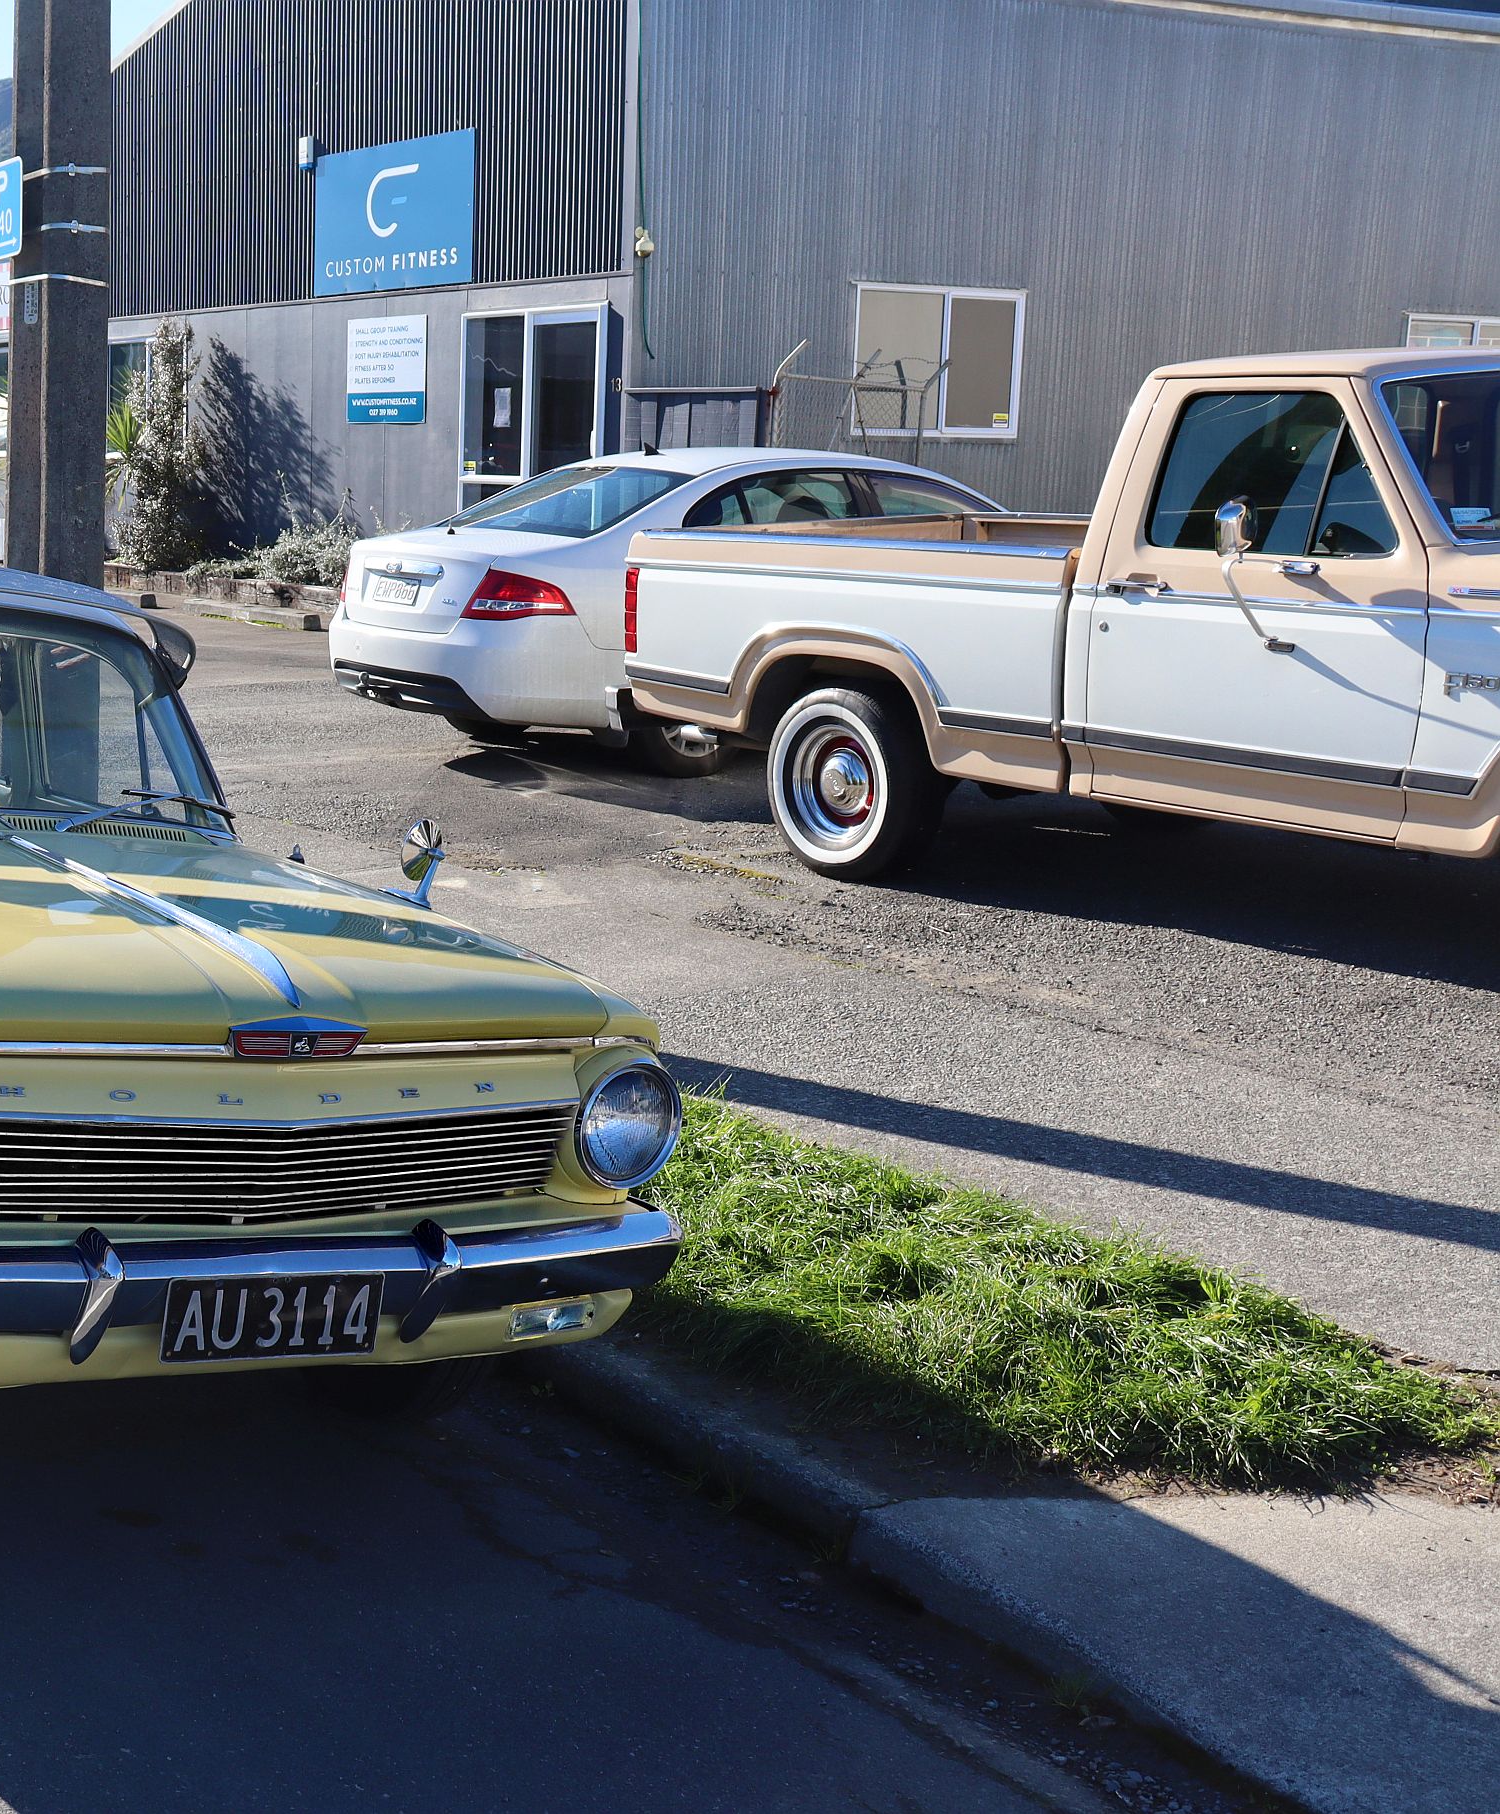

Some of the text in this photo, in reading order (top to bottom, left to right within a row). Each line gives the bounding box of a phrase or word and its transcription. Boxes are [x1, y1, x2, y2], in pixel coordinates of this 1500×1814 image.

[325, 247, 458, 278] CUSTOM FITNESS
[370, 326, 386, 334] GROUP
[387, 325, 409, 333] TRAINING
[389, 337, 423, 346] CONDITIONING
[383, 350, 419, 358] REHABILITATION
[611, 377, 621, 392] 13
[173, 1284, 370, 1352] AU3114
